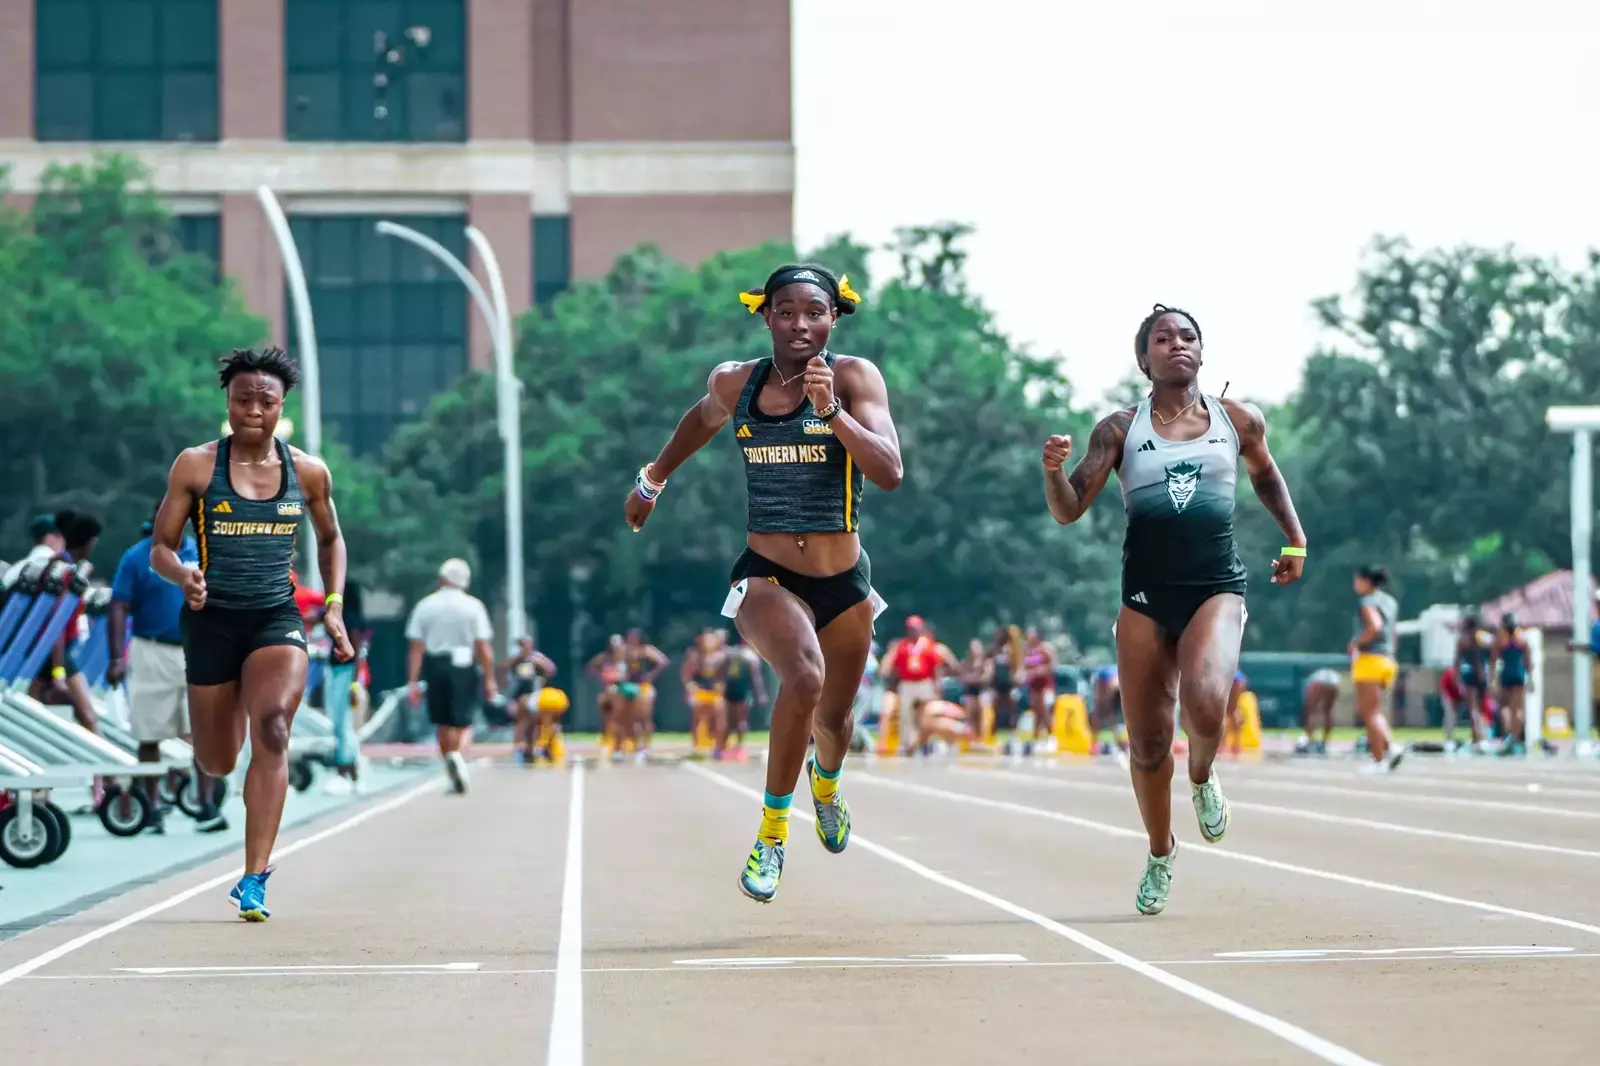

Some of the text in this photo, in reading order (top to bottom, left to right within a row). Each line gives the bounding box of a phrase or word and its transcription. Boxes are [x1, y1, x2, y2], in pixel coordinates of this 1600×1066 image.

[743, 445, 827, 463] SOUTHERN MISS
[212, 521, 272, 535] SOUTHERN
